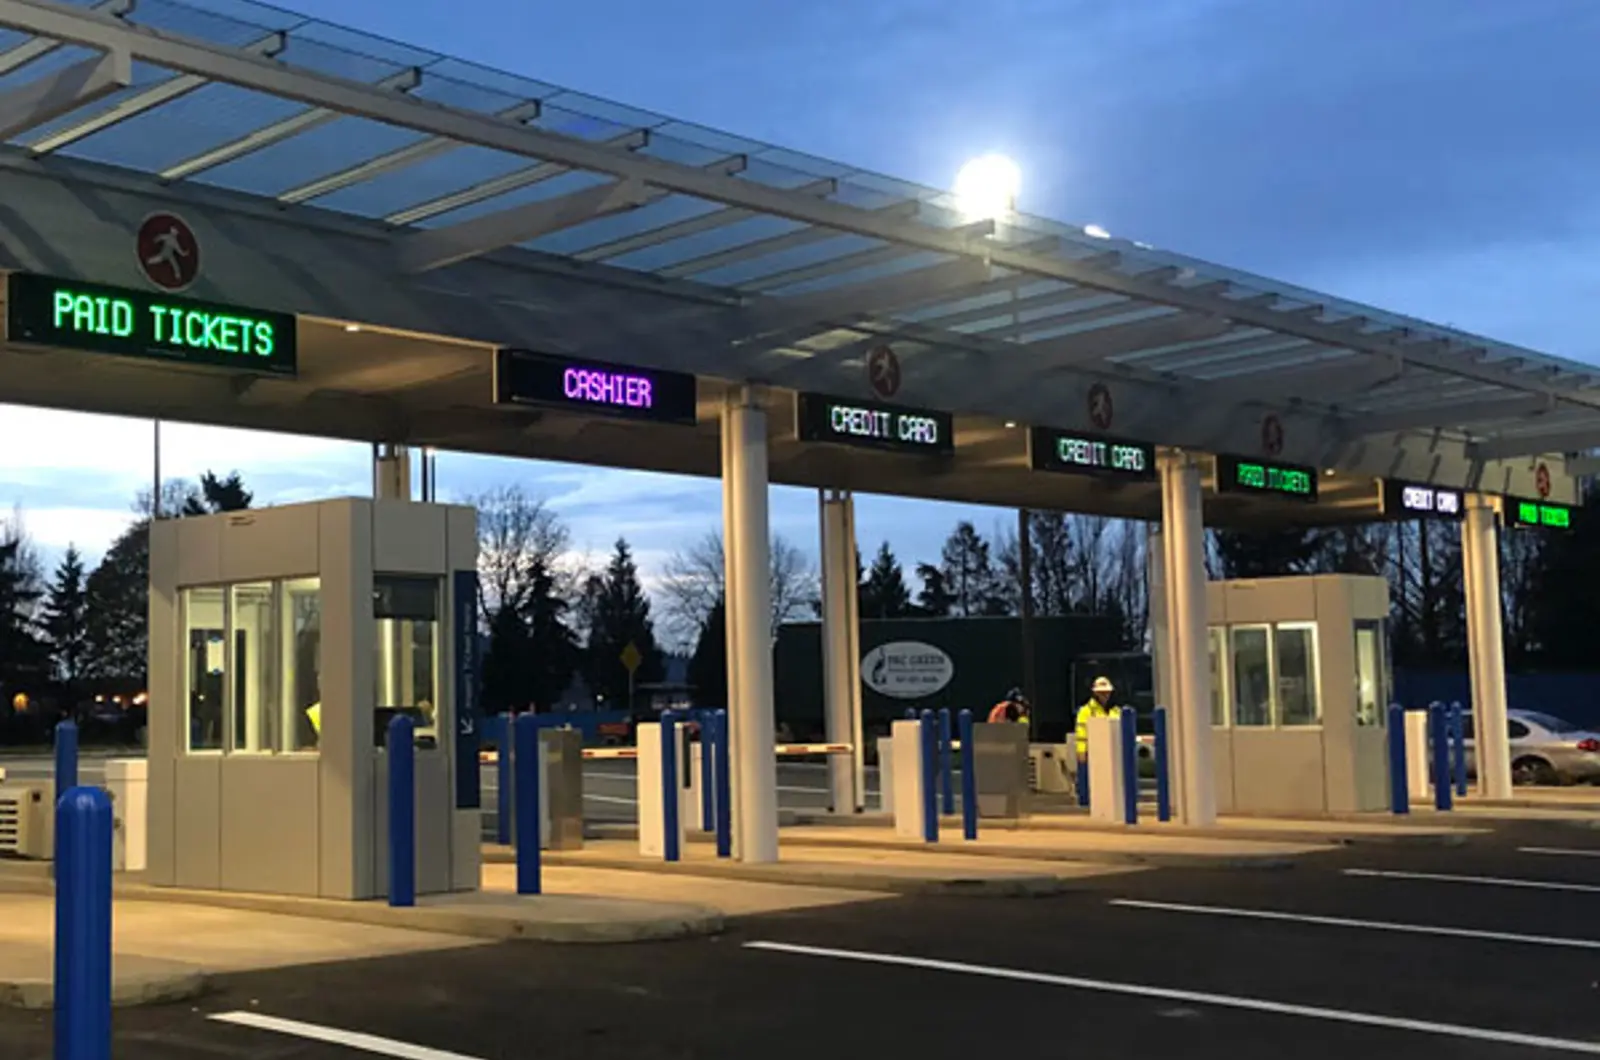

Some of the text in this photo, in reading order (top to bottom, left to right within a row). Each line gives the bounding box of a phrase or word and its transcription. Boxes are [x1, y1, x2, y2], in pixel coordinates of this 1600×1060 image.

[53, 290, 274, 356] PAID TICKETS
[564, 368, 652, 408] CASHIER
[831, 405, 938, 444] CREDIT CARD
[1058, 437, 1106, 466] CREDIT
